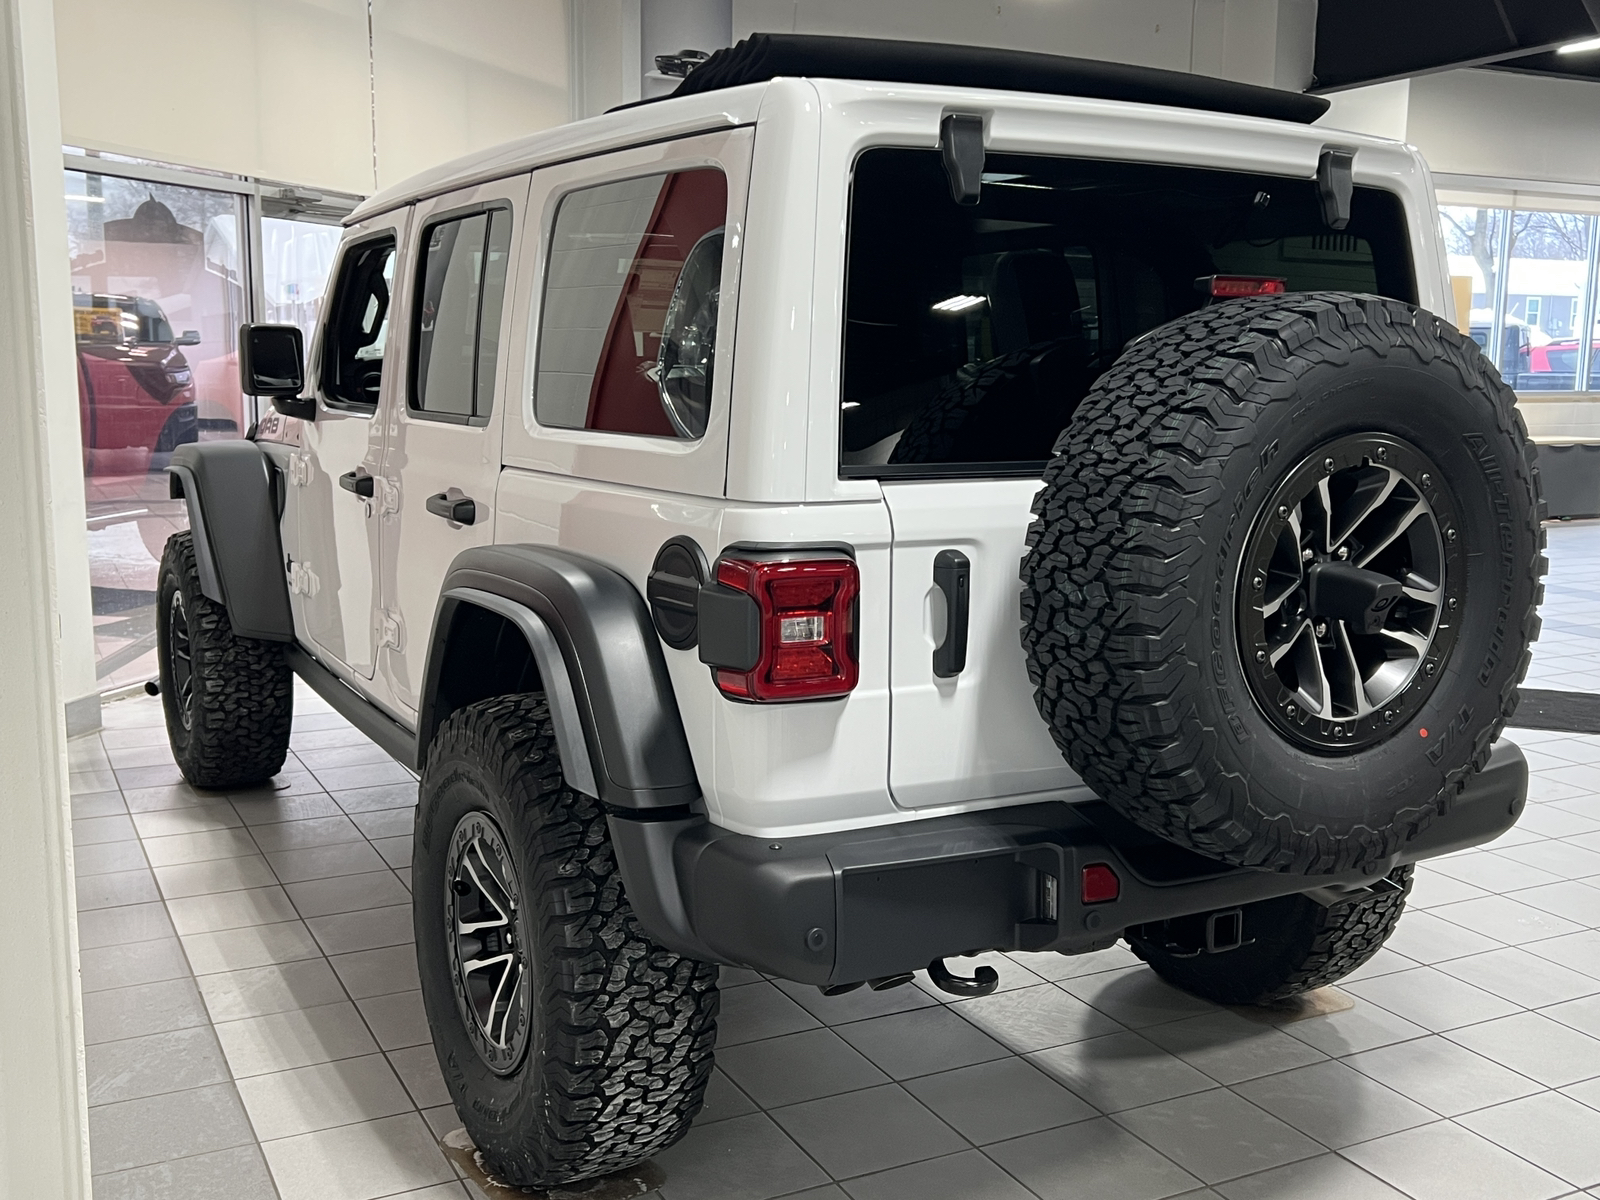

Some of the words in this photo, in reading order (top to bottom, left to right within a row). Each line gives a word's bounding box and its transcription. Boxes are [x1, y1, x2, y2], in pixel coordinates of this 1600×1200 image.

[257, 417, 280, 435] OAB
[1211, 438, 1279, 744] BFGoodrich
[1462, 432, 1514, 687] All-Terrain
[1425, 703, 1474, 766] T/A
